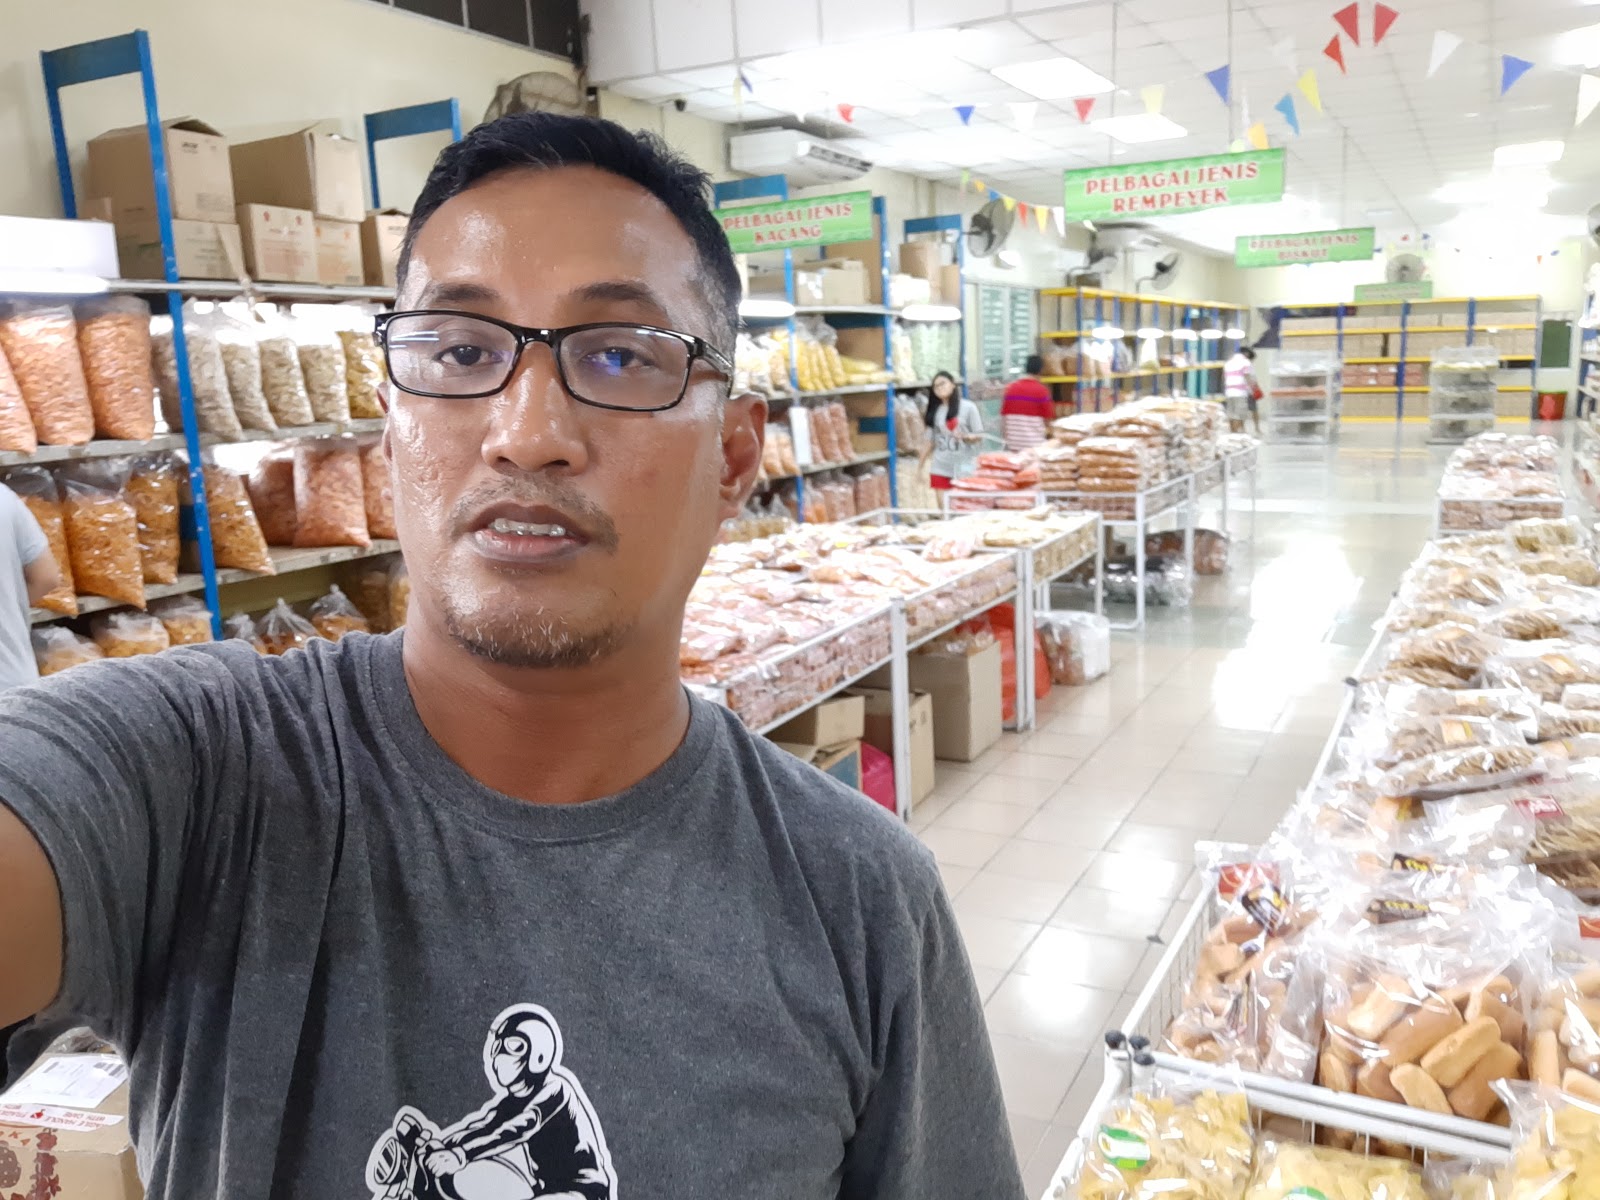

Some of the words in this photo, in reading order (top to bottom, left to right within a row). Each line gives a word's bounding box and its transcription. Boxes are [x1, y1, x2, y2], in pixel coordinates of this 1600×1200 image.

[1086, 170, 1190, 194] PELBAGAI
[1197, 161, 1259, 184] JENIS
[1113, 187, 1229, 213] REMPEYEK
[723, 208, 802, 230] PELBAGAI
[806, 203, 852, 221] JENIS
[755, 225, 821, 243] KACANG
